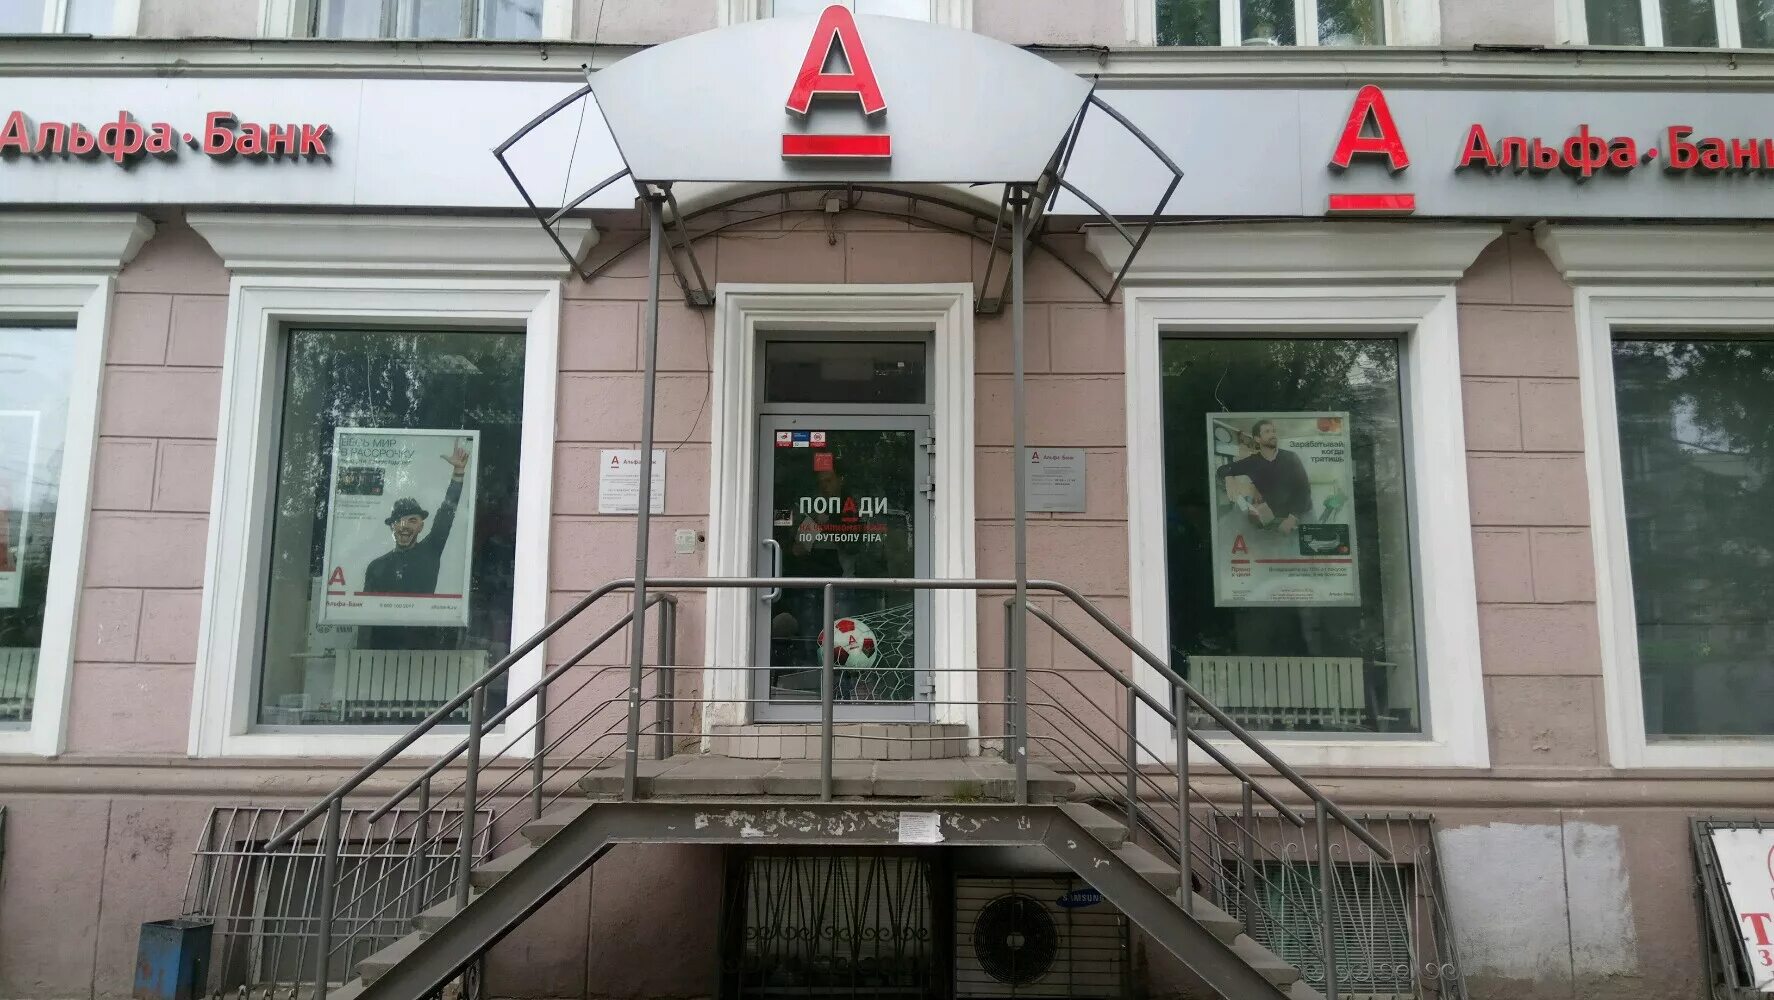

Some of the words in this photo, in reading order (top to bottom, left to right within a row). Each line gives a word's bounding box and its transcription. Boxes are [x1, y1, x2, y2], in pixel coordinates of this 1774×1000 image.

[784, 3, 888, 118] А
[1331, 84, 1411, 172] А
[372, 438, 397, 447] МИР
[350, 448, 415, 458] РАССРОЧКУ
[799, 496, 888, 518] ПОПАДИ
[799, 533, 812, 542] ПО
[815, 533, 860, 542] ФУТБОЛУ
